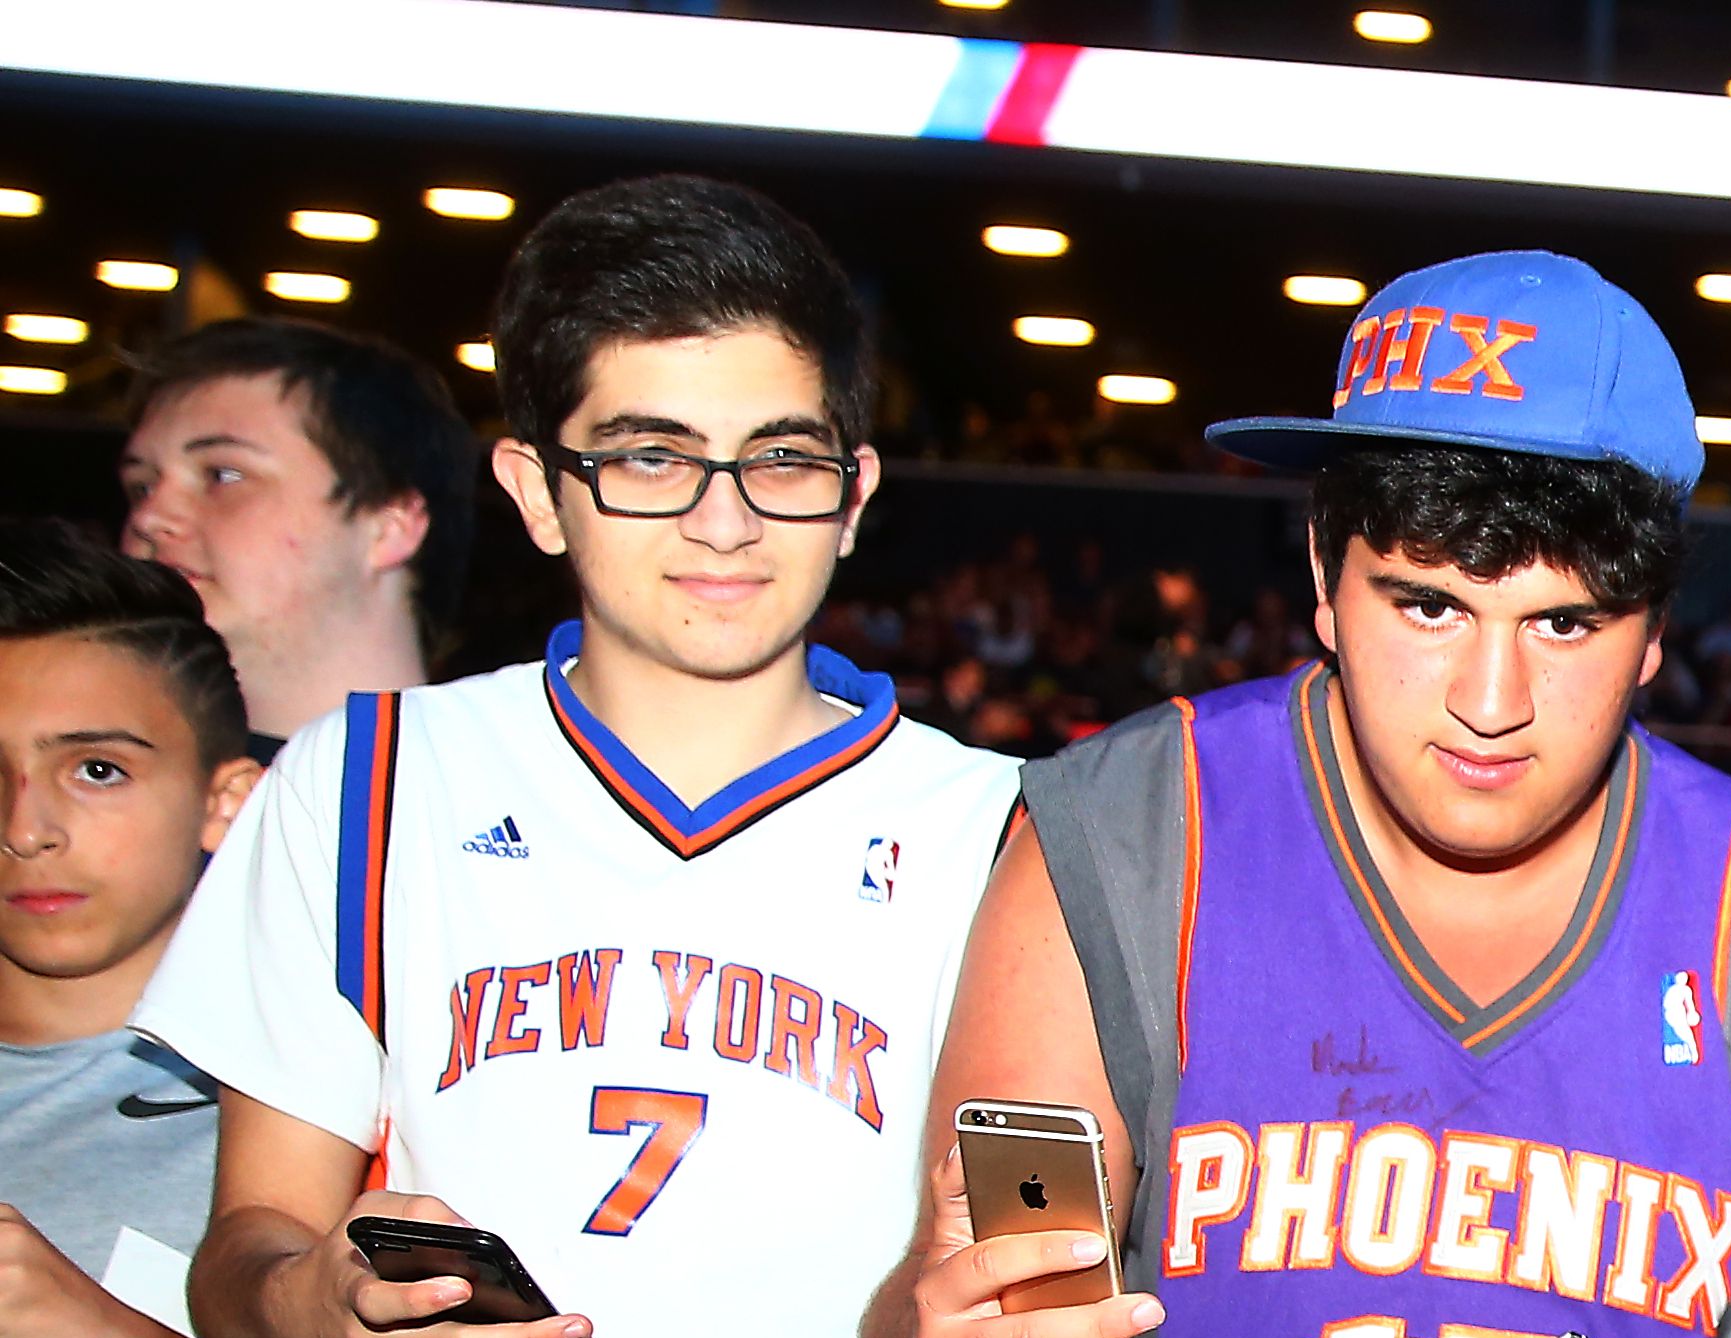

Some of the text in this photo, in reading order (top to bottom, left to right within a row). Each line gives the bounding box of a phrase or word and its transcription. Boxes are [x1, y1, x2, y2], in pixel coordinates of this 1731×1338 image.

[1332, 305, 1538, 410] PHX
[462, 841, 530, 859] adidas
[435, 948, 888, 1134] NEW YORK
[581, 1085, 709, 1237] 7
